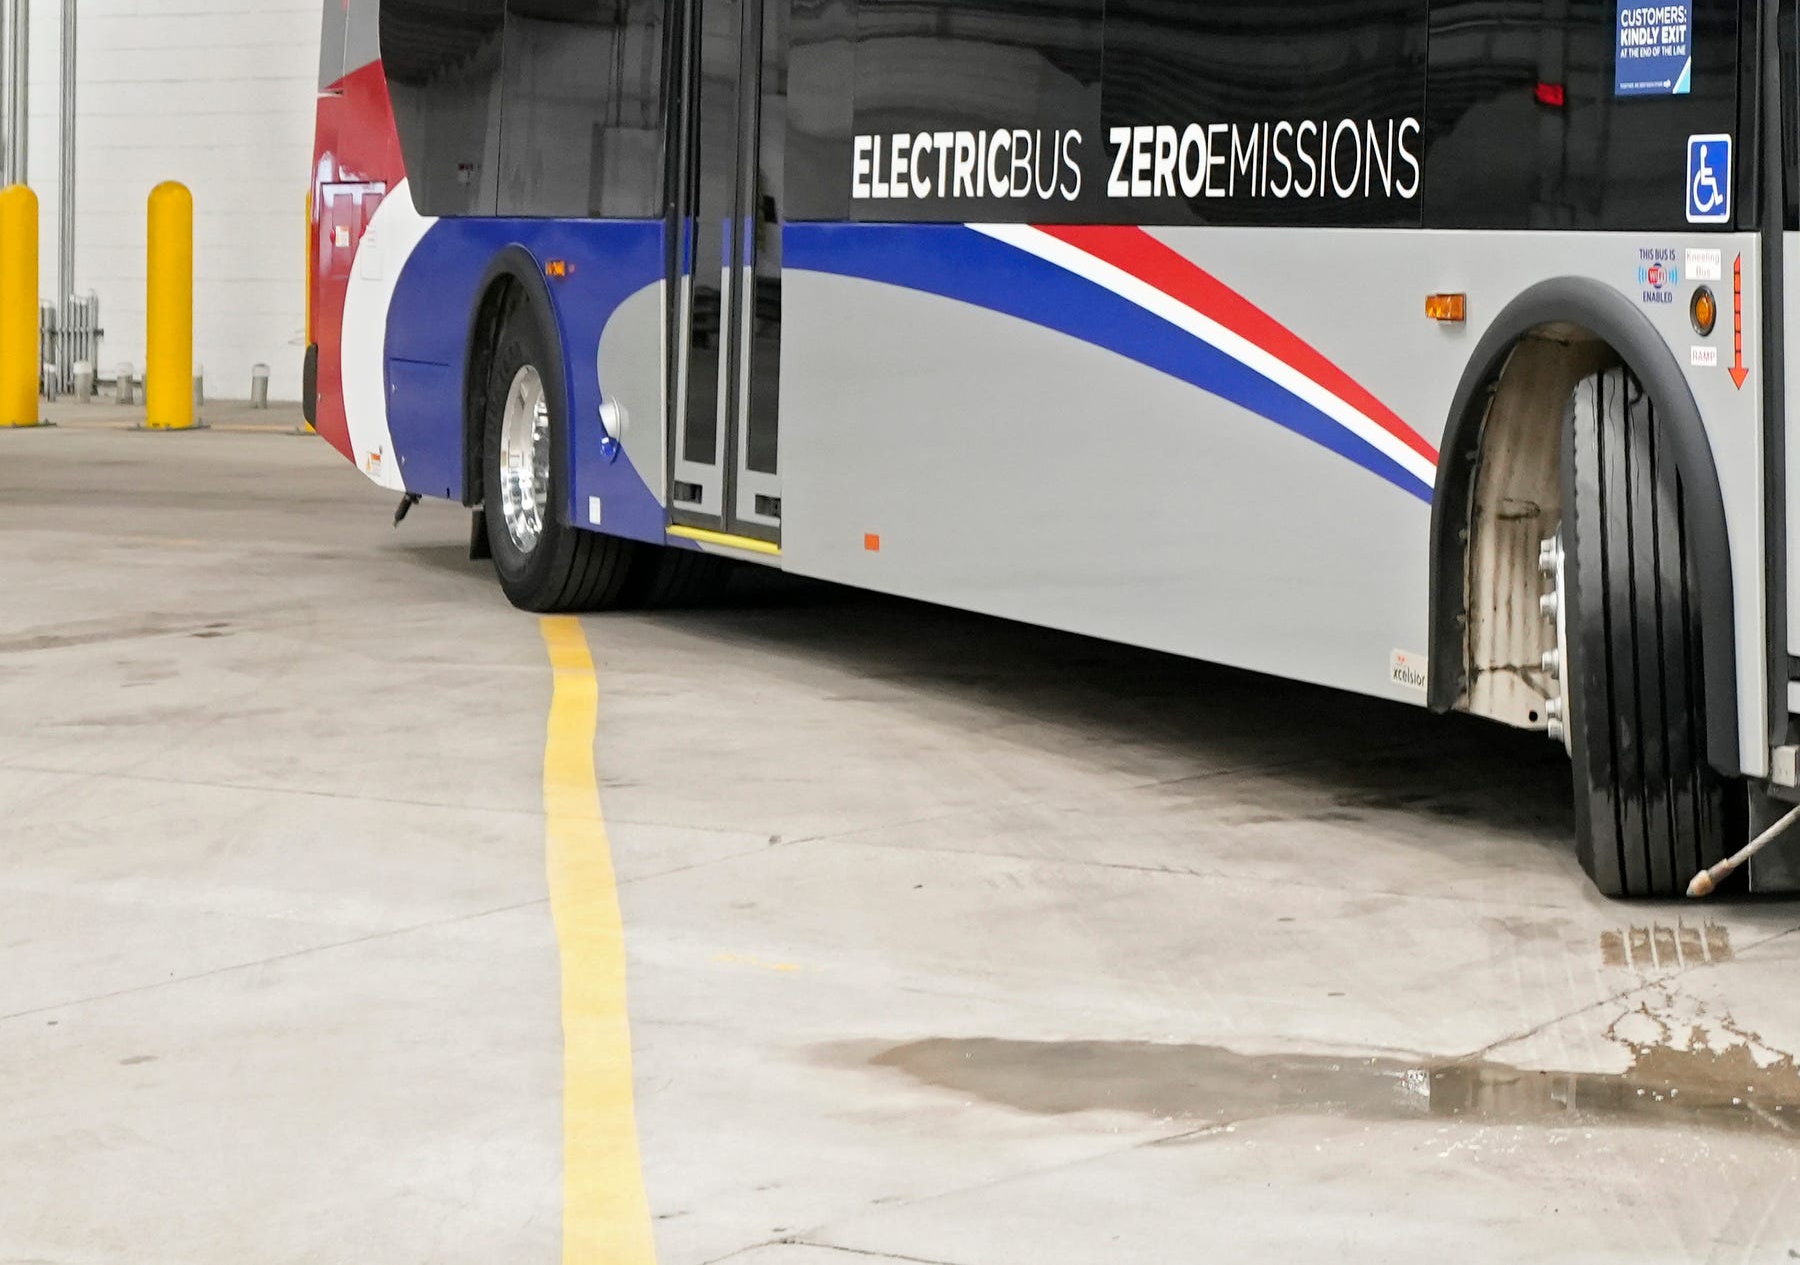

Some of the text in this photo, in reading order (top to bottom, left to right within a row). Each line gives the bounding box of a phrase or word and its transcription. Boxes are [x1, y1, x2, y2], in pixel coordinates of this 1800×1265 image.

[1620, 5, 1687, 27] CUSTOMERS:
[1620, 24, 1687, 47] KINDLY EXIT
[1629, 47, 1639, 58] THE
[1640, 46, 1652, 58] END
[1639, 248, 1676, 261] THIS BUS IS
[1687, 252, 1720, 265] Kneeling
[1642, 290, 1673, 304] ENABLED
[1692, 349, 1716, 362] RAMP
[1393, 666, 1426, 687] xcelsior
